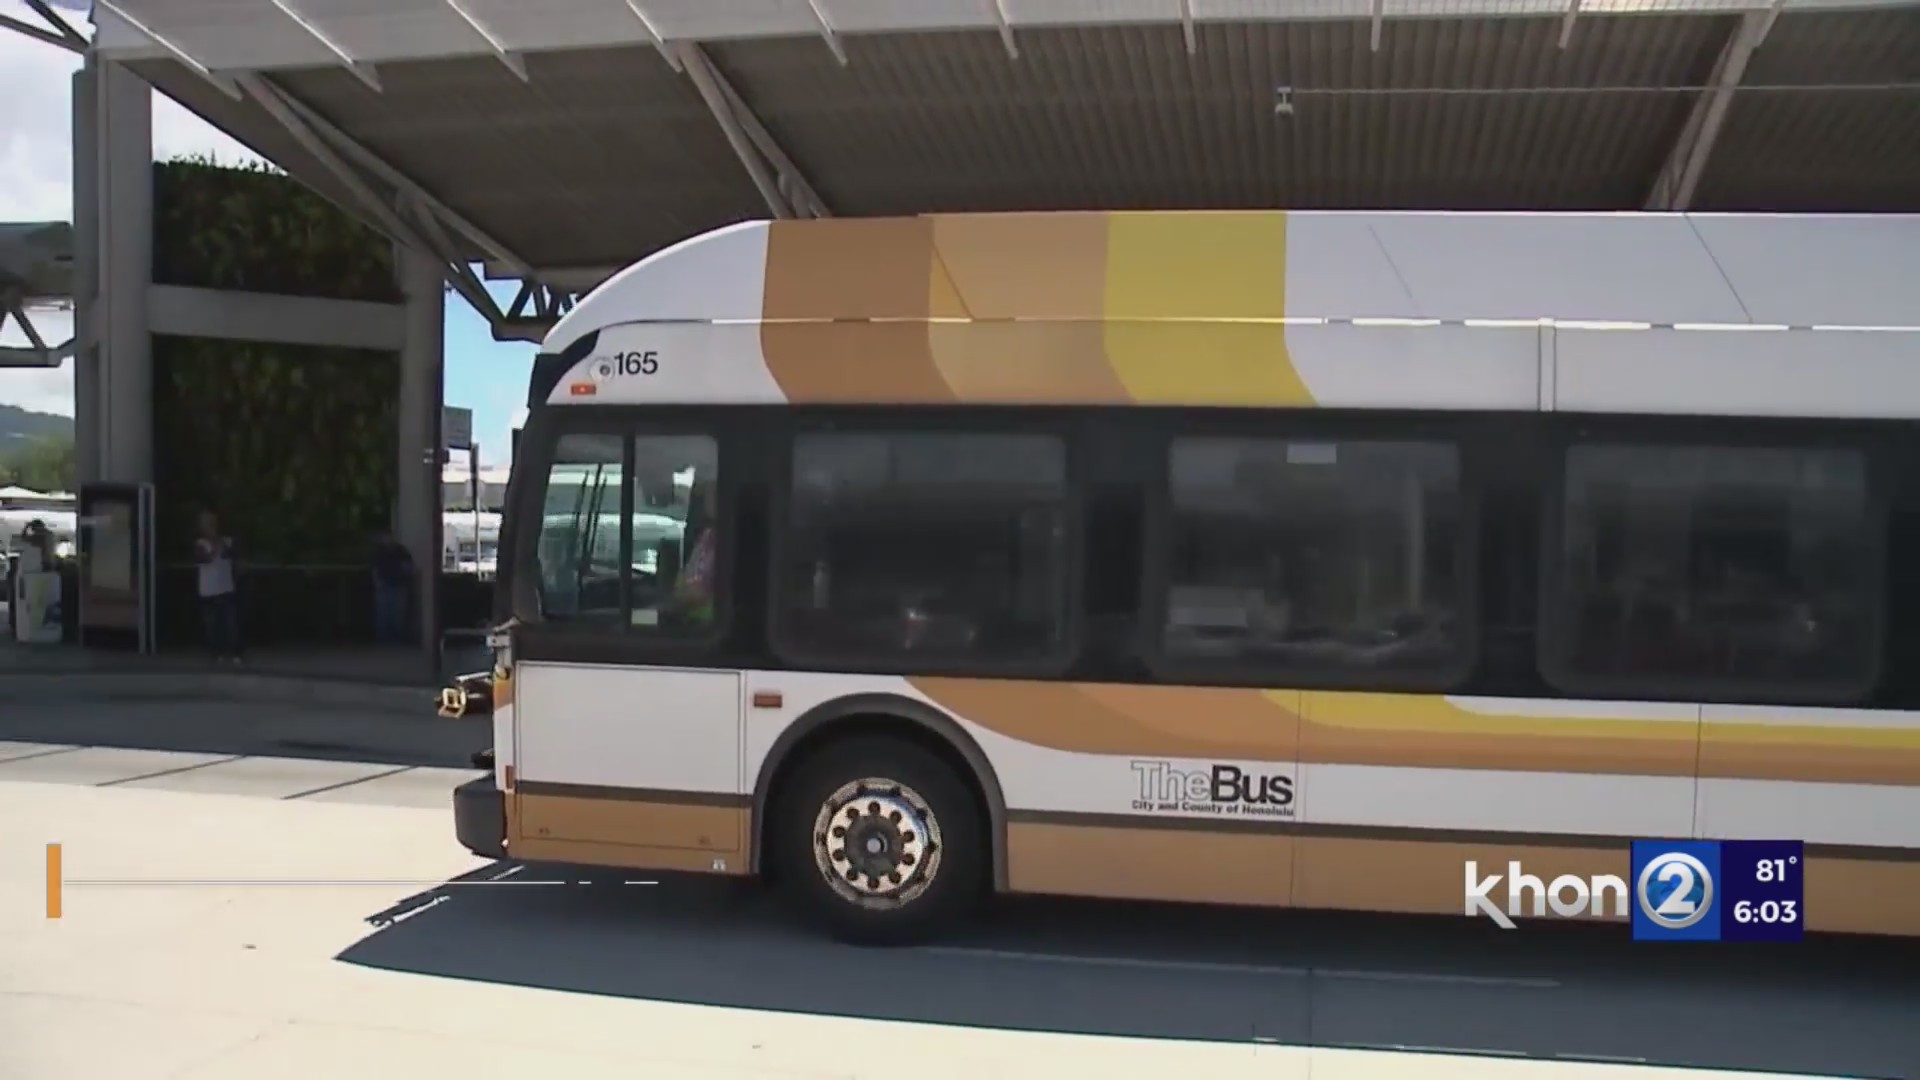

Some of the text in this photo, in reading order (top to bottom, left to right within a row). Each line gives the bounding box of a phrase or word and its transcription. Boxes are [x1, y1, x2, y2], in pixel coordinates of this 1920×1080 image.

[614, 351, 658, 376] 165
[1130, 760, 1294, 805] TheBus
[1132, 800, 1294, 816] City and County of Honolulu
